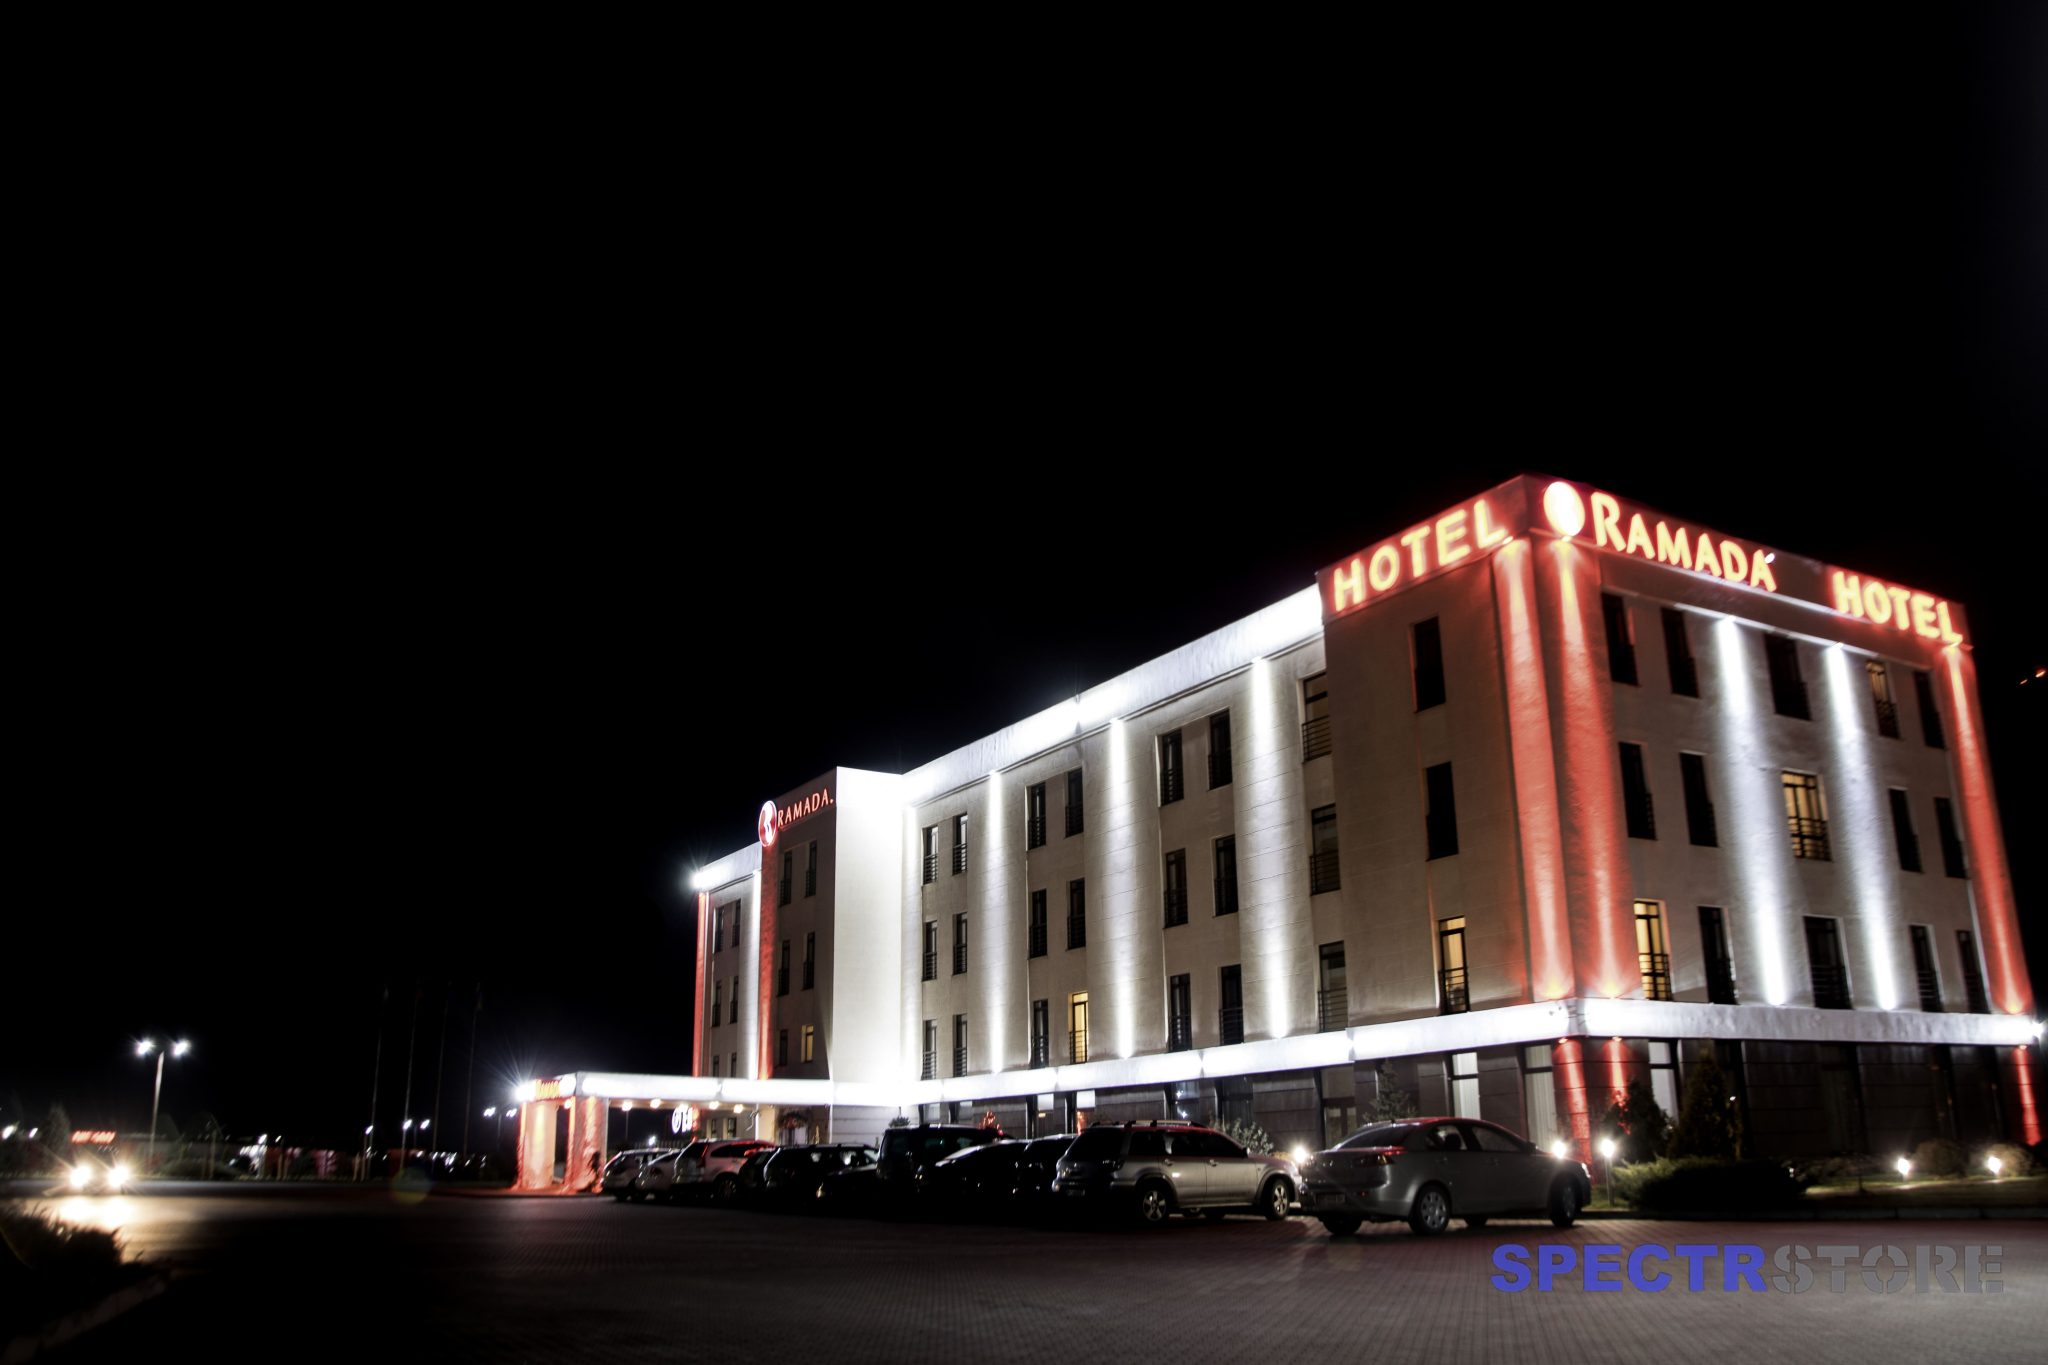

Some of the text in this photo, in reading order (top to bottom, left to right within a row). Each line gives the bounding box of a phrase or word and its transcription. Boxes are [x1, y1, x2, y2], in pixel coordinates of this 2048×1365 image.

[1333, 498, 1508, 612] HOTEL
[1590, 491, 1963, 644] RAMADA HOTEL
